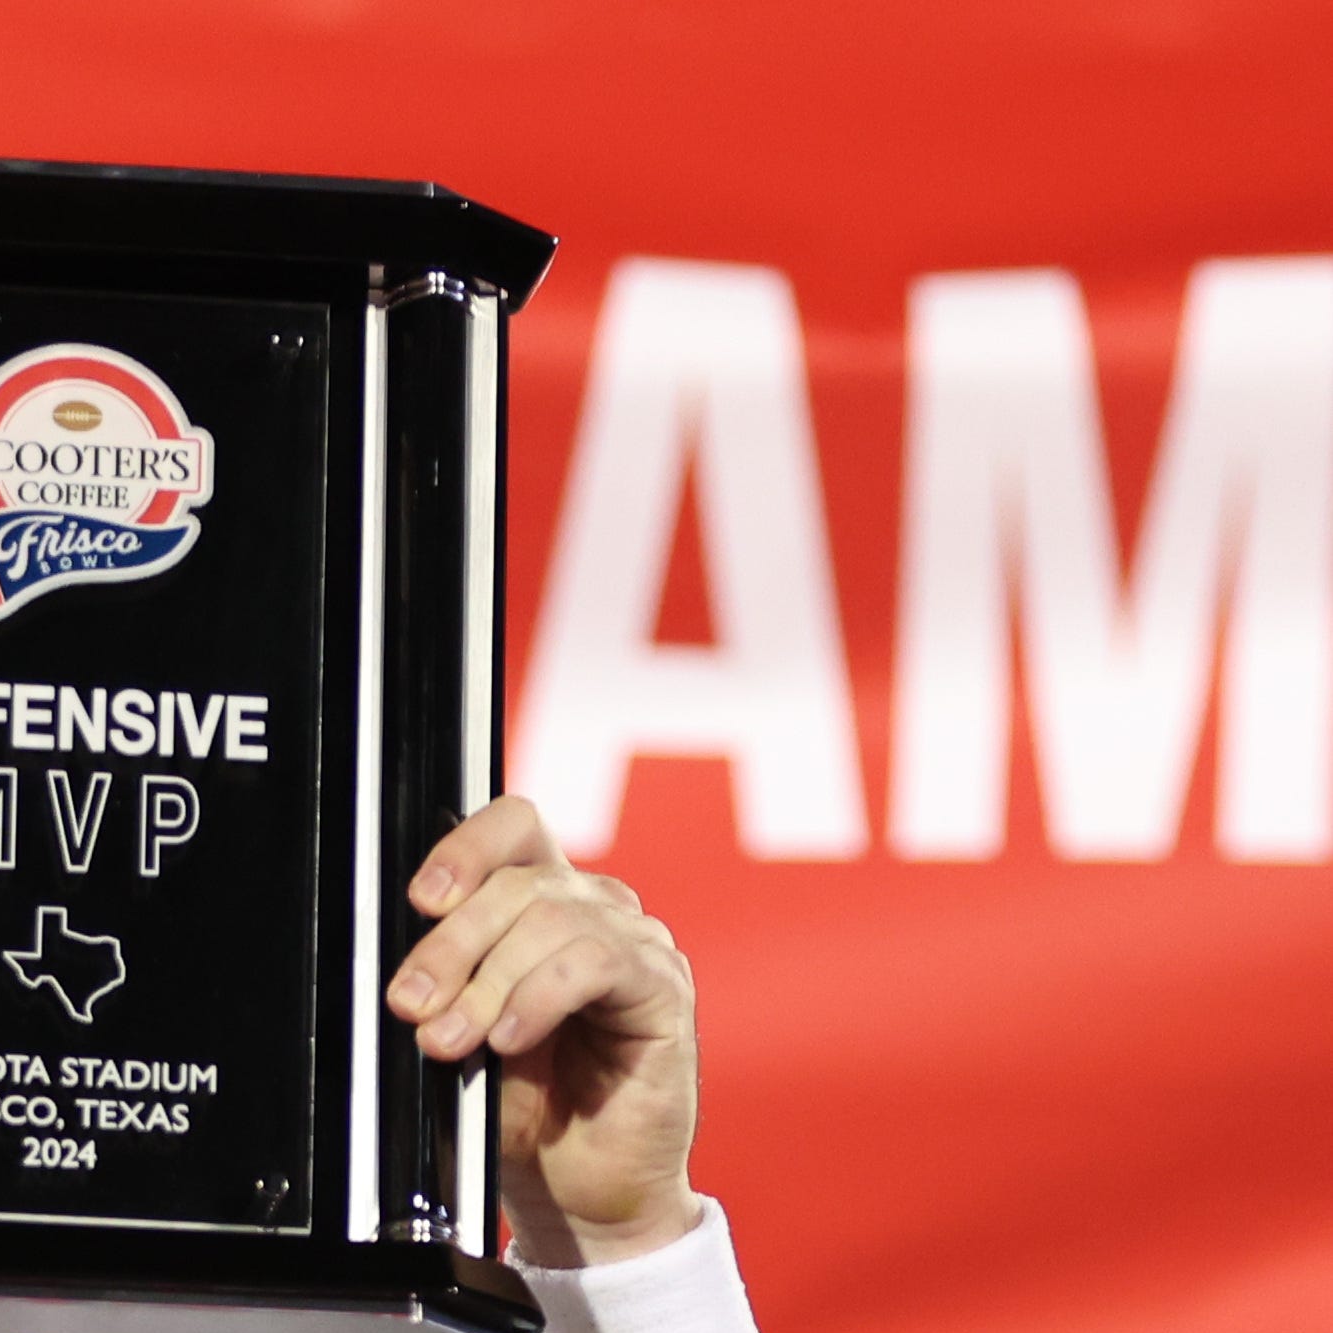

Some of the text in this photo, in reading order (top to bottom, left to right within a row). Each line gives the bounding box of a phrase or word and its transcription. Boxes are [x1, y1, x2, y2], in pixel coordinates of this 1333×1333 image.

[17, 480, 130, 510] COFFEE
[40, 554, 116, 575] BOWL
[61, 1057, 217, 1094] STADIUM
[76, 1098, 190, 1133] TEXAS
[22, 1137, 97, 1169] 2024
